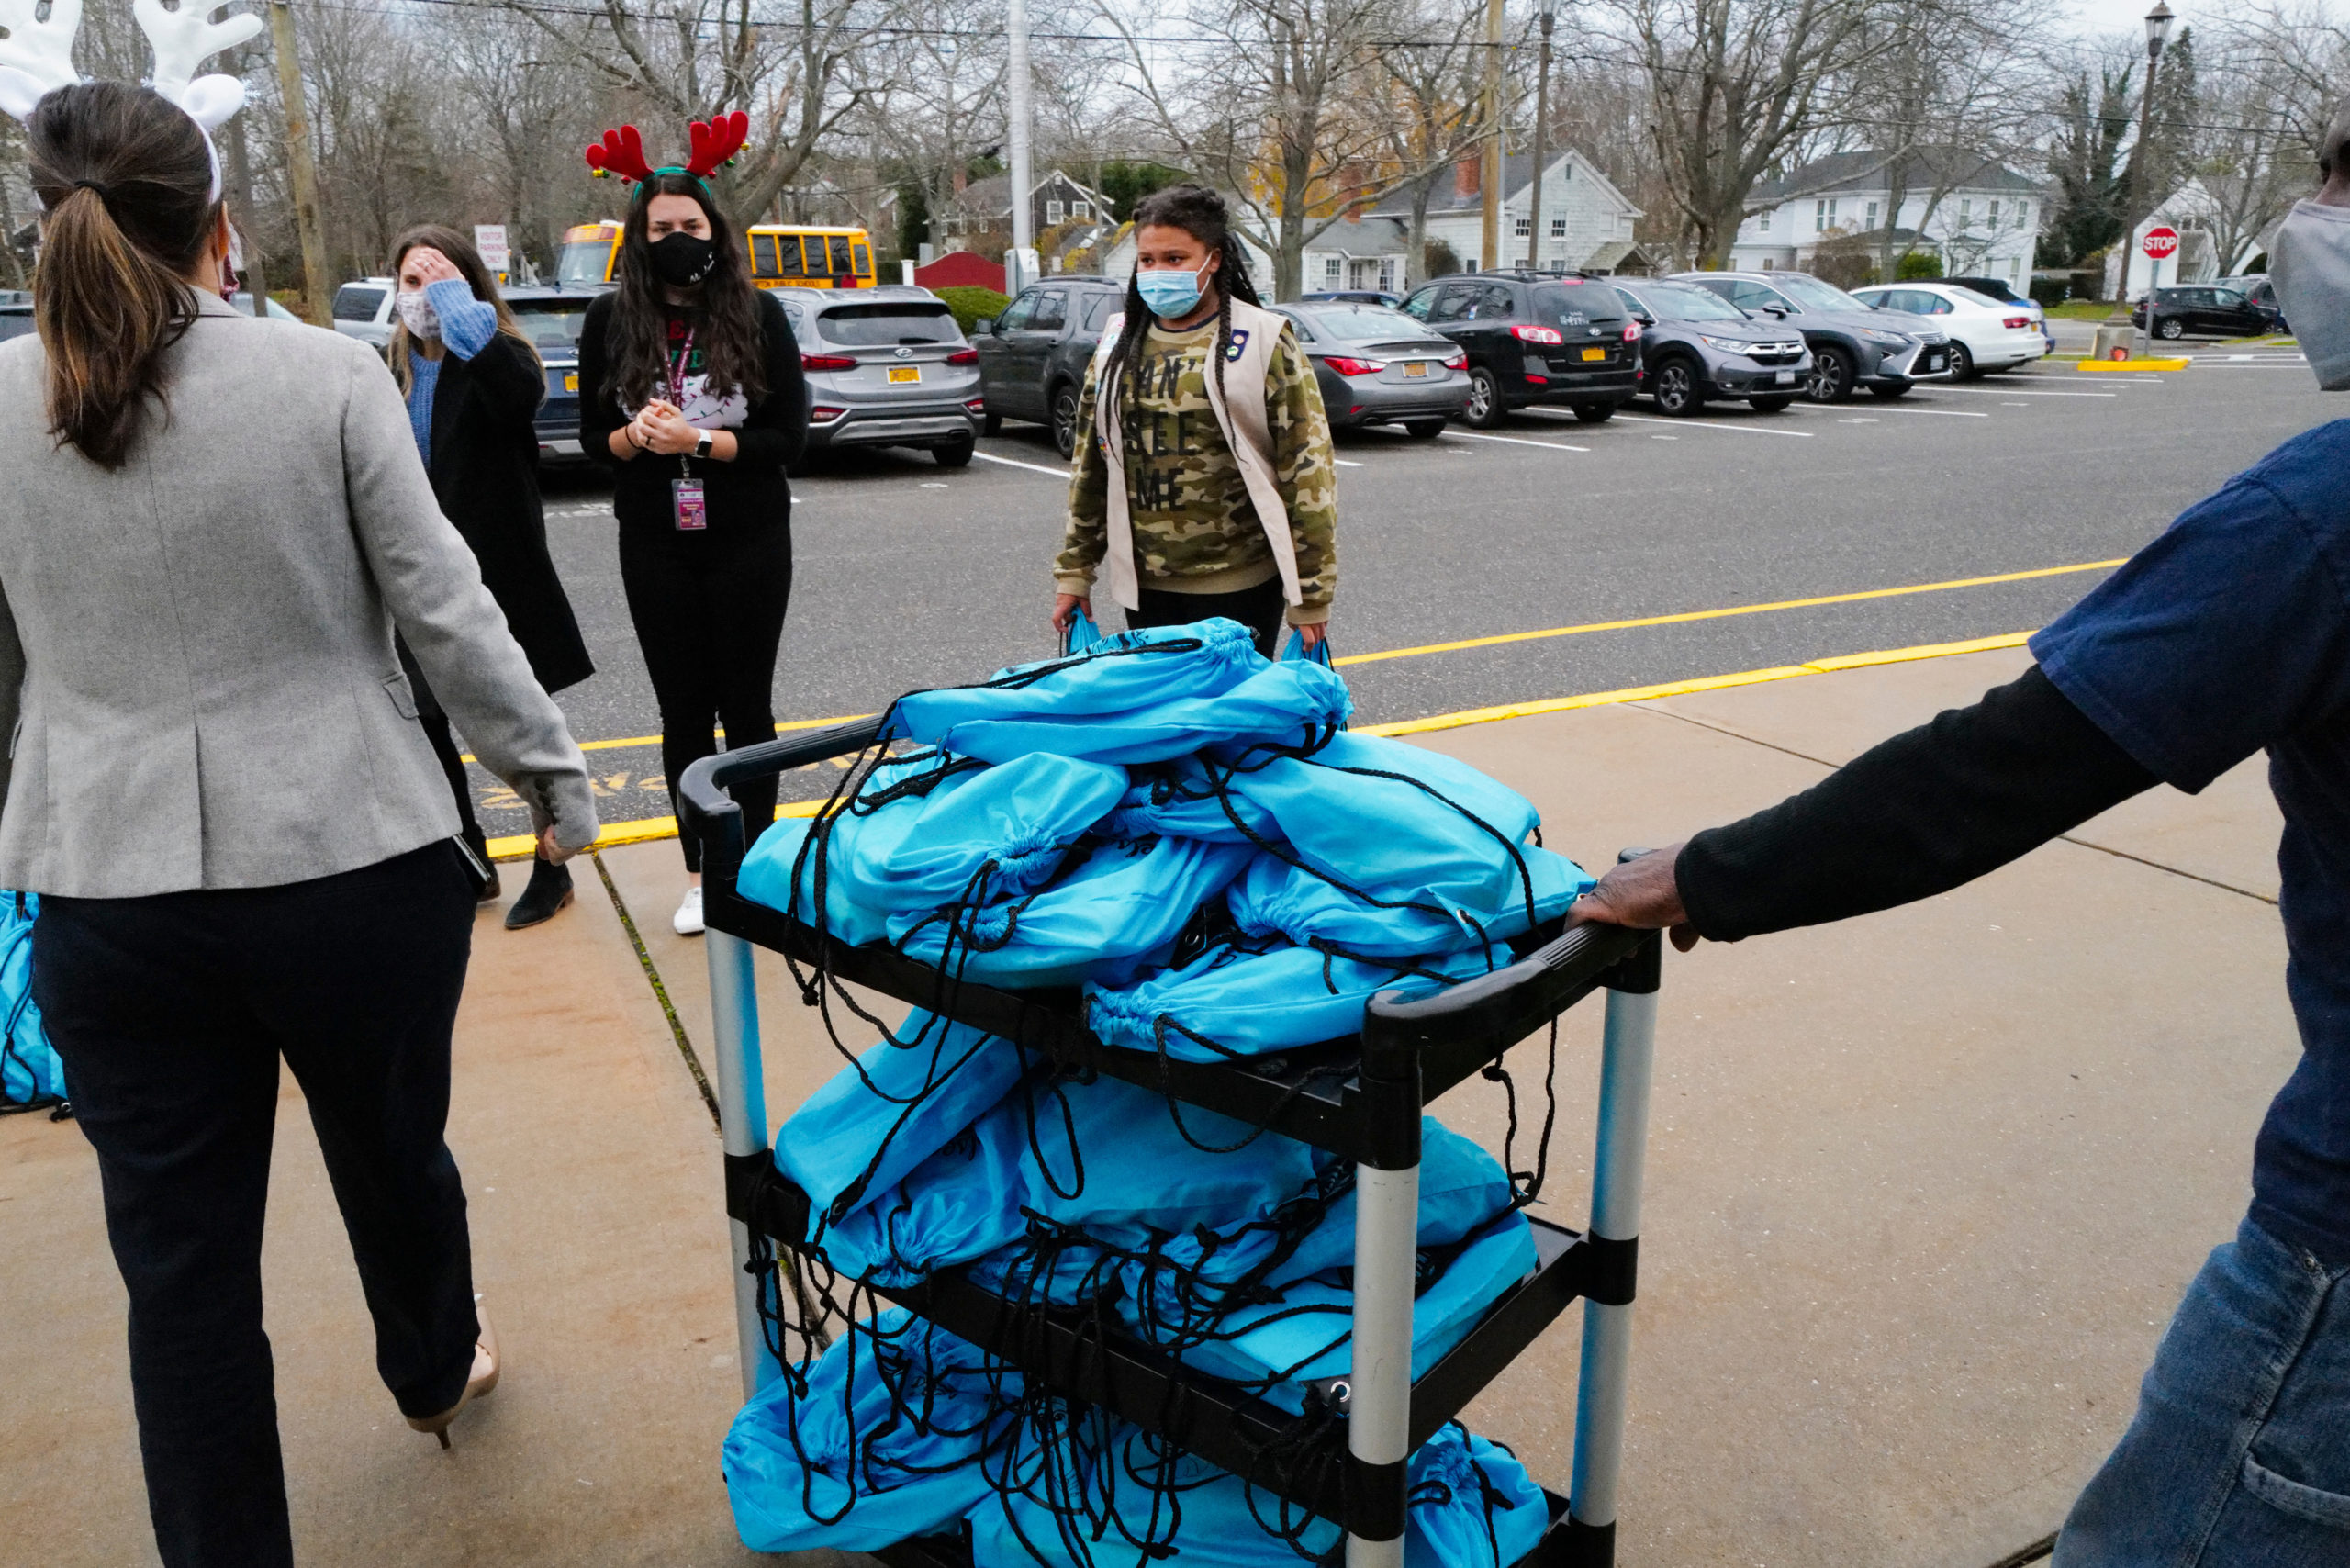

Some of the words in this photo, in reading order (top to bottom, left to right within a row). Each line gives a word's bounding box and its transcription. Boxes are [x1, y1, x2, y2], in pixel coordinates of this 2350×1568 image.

[479, 243, 507, 252] PARKING
[2143, 236, 2177, 250] STOP
[1122, 357, 1206, 399] AN'
[1126, 411, 1199, 456] SEE
[1136, 467, 1187, 511] ME
